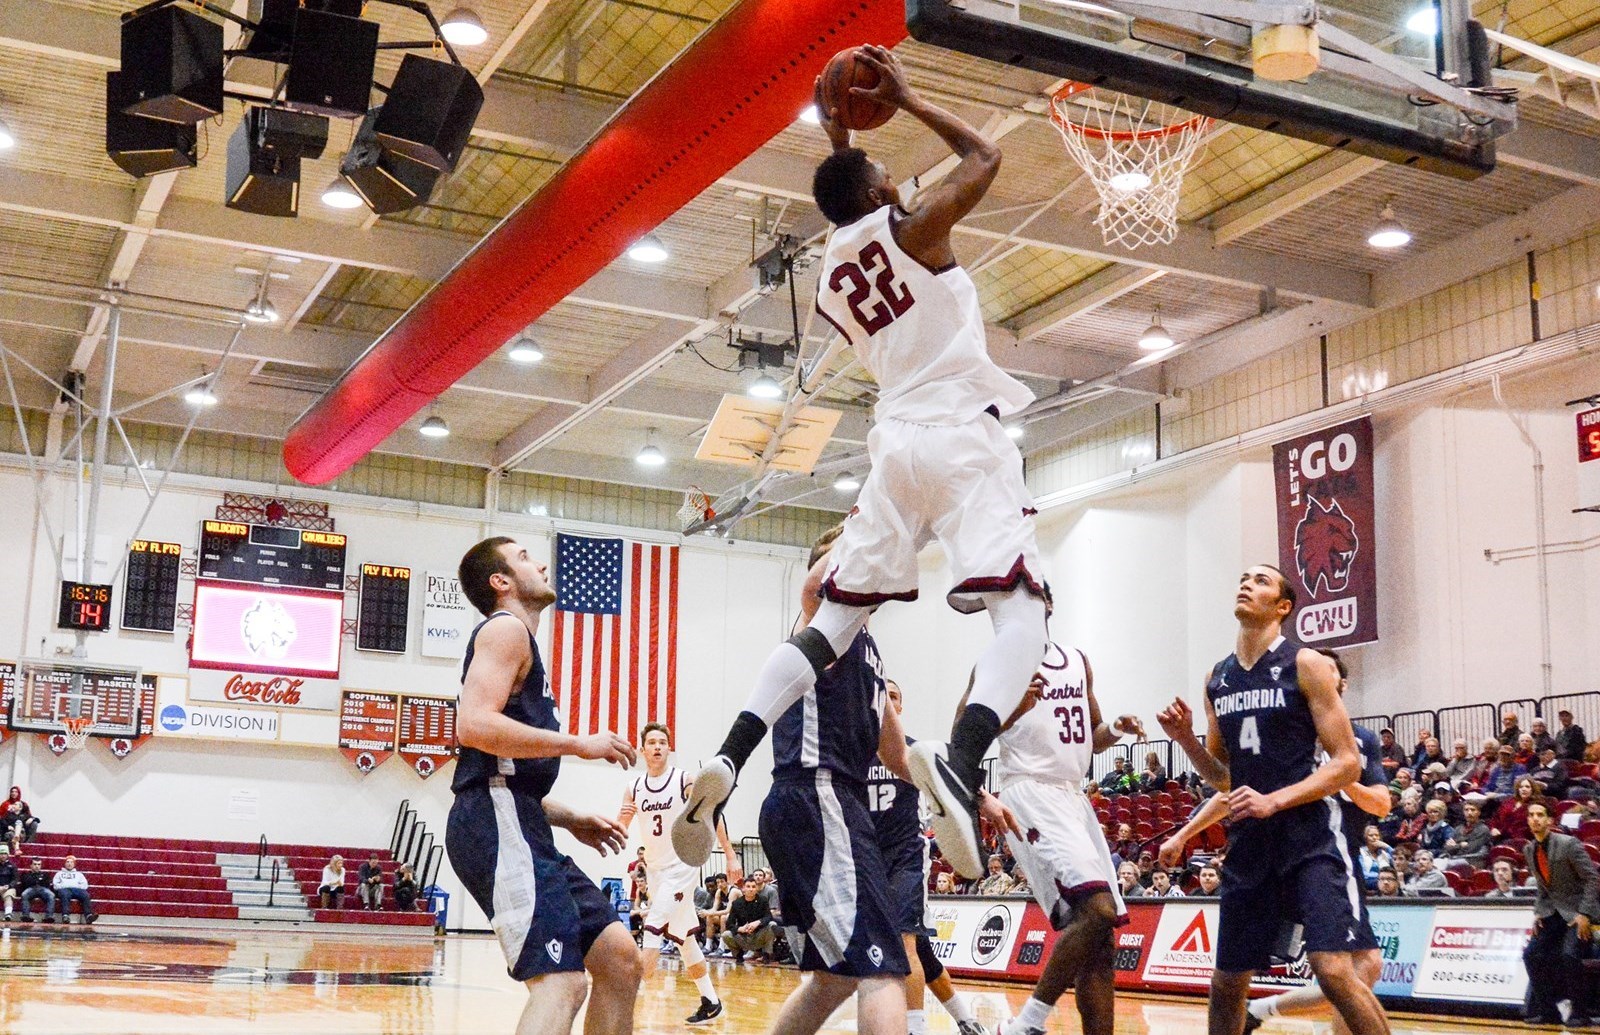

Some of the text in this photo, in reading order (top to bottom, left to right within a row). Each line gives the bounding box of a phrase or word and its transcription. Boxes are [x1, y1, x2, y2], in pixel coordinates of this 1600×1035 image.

[828, 240, 916, 337] 22
[1301, 433, 1357, 479] GO
[1289, 448, 1300, 507] LET'S
[150, 542, 161, 553] FL
[162, 543, 181, 555] PTS
[364, 565, 409, 579] PLY FL PTS
[428, 576, 462, 593] PALAC
[433, 591, 461, 605] CAFE
[80, 603, 101, 625] 14
[1300, 603, 1353, 636] CWU
[224, 674, 304, 705] Coca-Cola
[349, 693, 391, 702] SOFTBALL
[1042, 679, 1083, 700] Central
[377, 702, 395, 710] 2011
[408, 698, 449, 707] FOOTBALL
[1214, 687, 1287, 717] CONCORDIA
[191, 713, 277, 731] DIVISION II
[1054, 706, 1085, 744] 33
[1239, 715, 1261, 755] 4
[641, 796, 673, 812] Central
[867, 783, 897, 811] 12
[653, 814, 663, 837] 3
[1026, 930, 1047, 942] HOME
[1119, 934, 1144, 946] GUEST
[1433, 928, 1489, 946] Central
[1163, 953, 1214, 963] ANDERSON
[1382, 962, 1417, 984] OOKS
